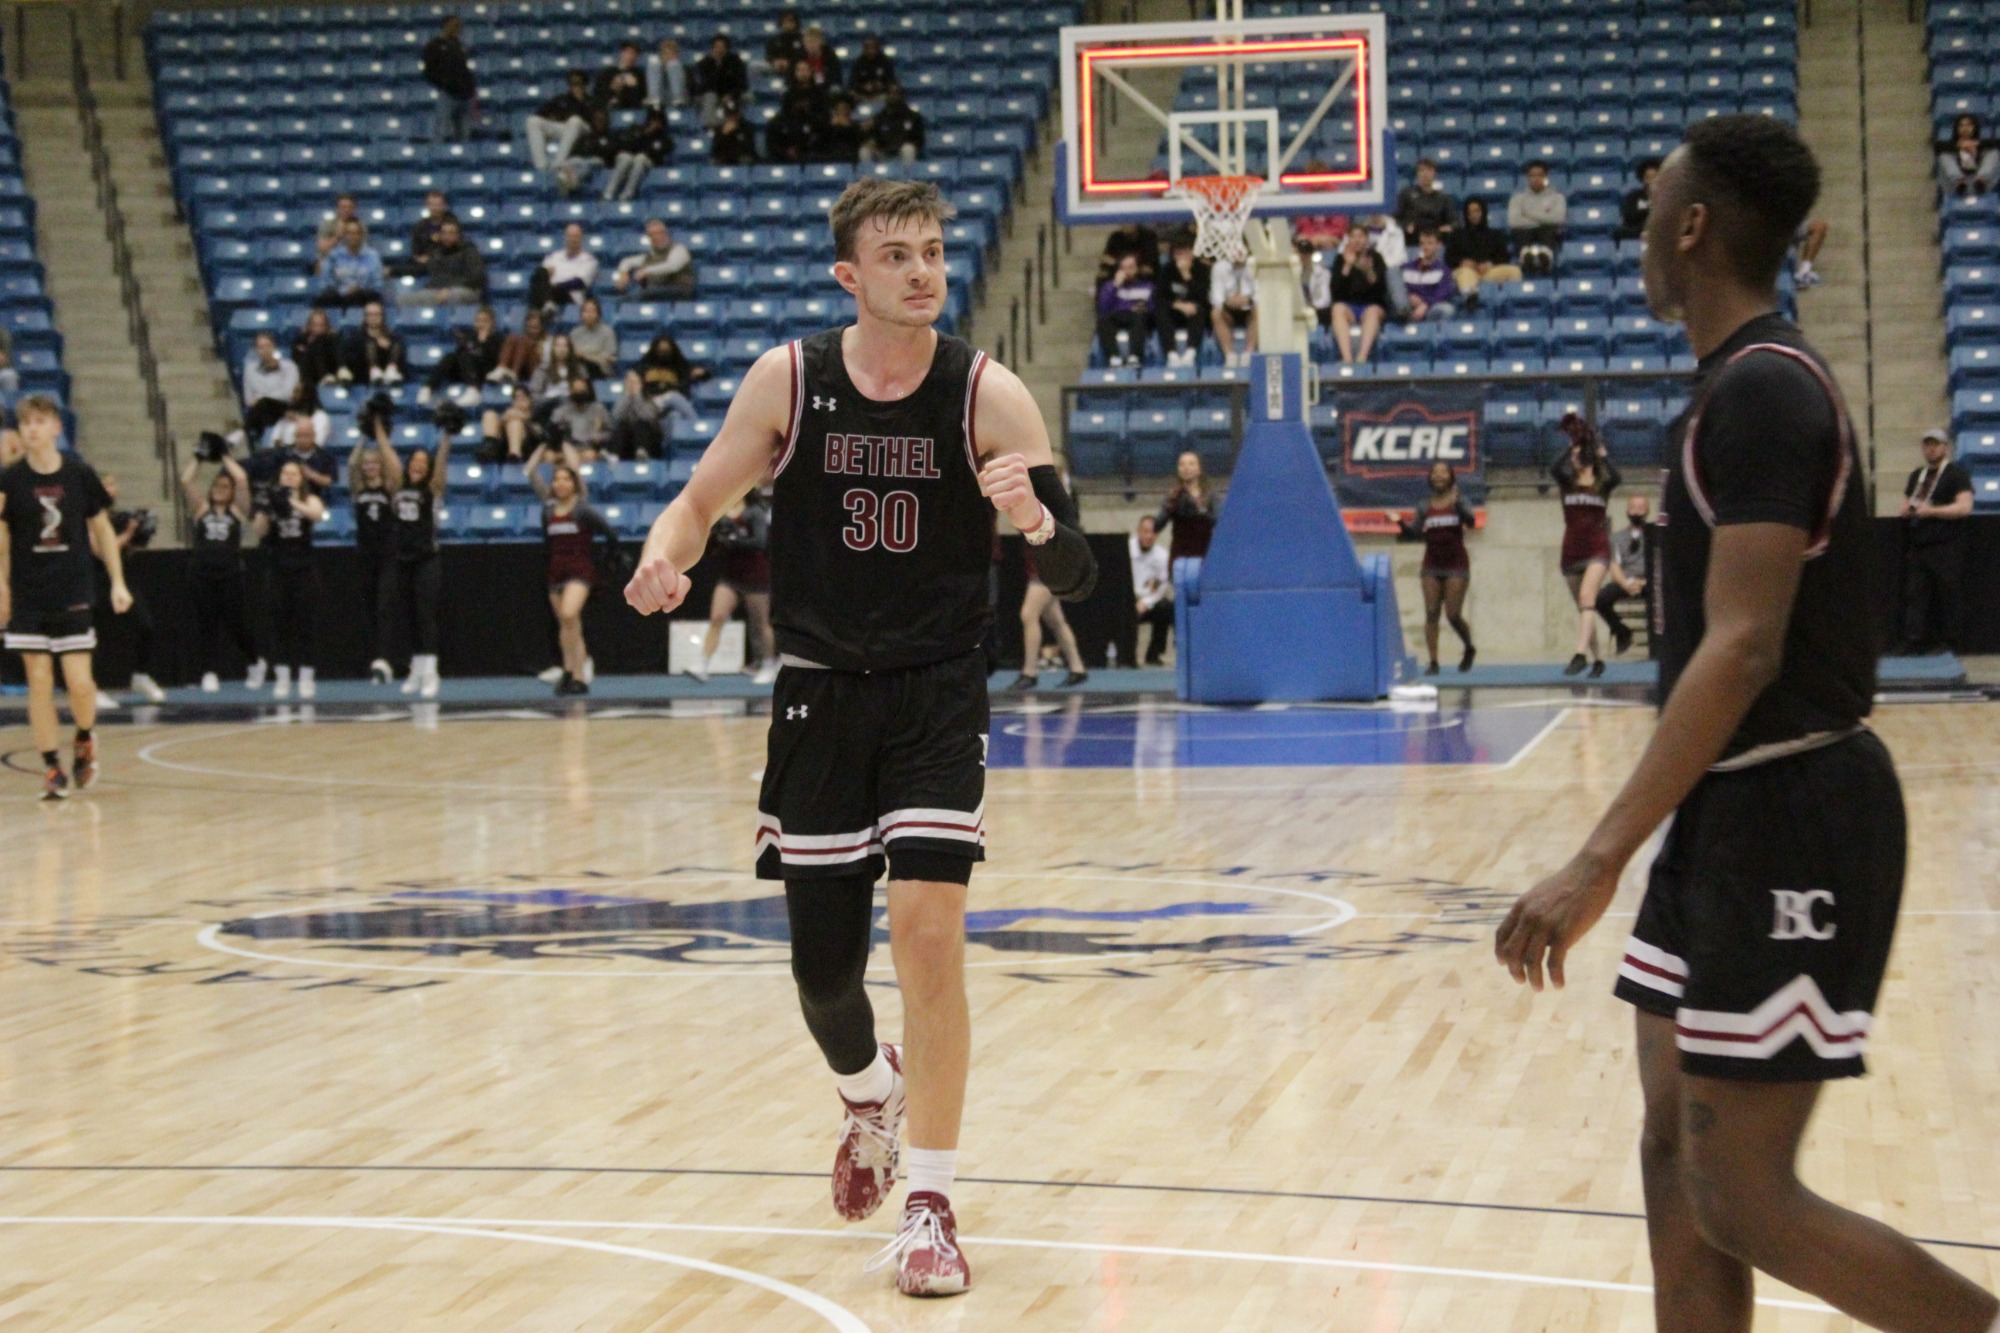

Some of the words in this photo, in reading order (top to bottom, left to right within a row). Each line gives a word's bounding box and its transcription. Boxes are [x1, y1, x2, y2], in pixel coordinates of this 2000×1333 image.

[824, 432, 941, 479] BETHEL
[1352, 425, 1469, 461] KCAC
[842, 488, 919, 552] 30
[1768, 889, 1838, 940] BC
